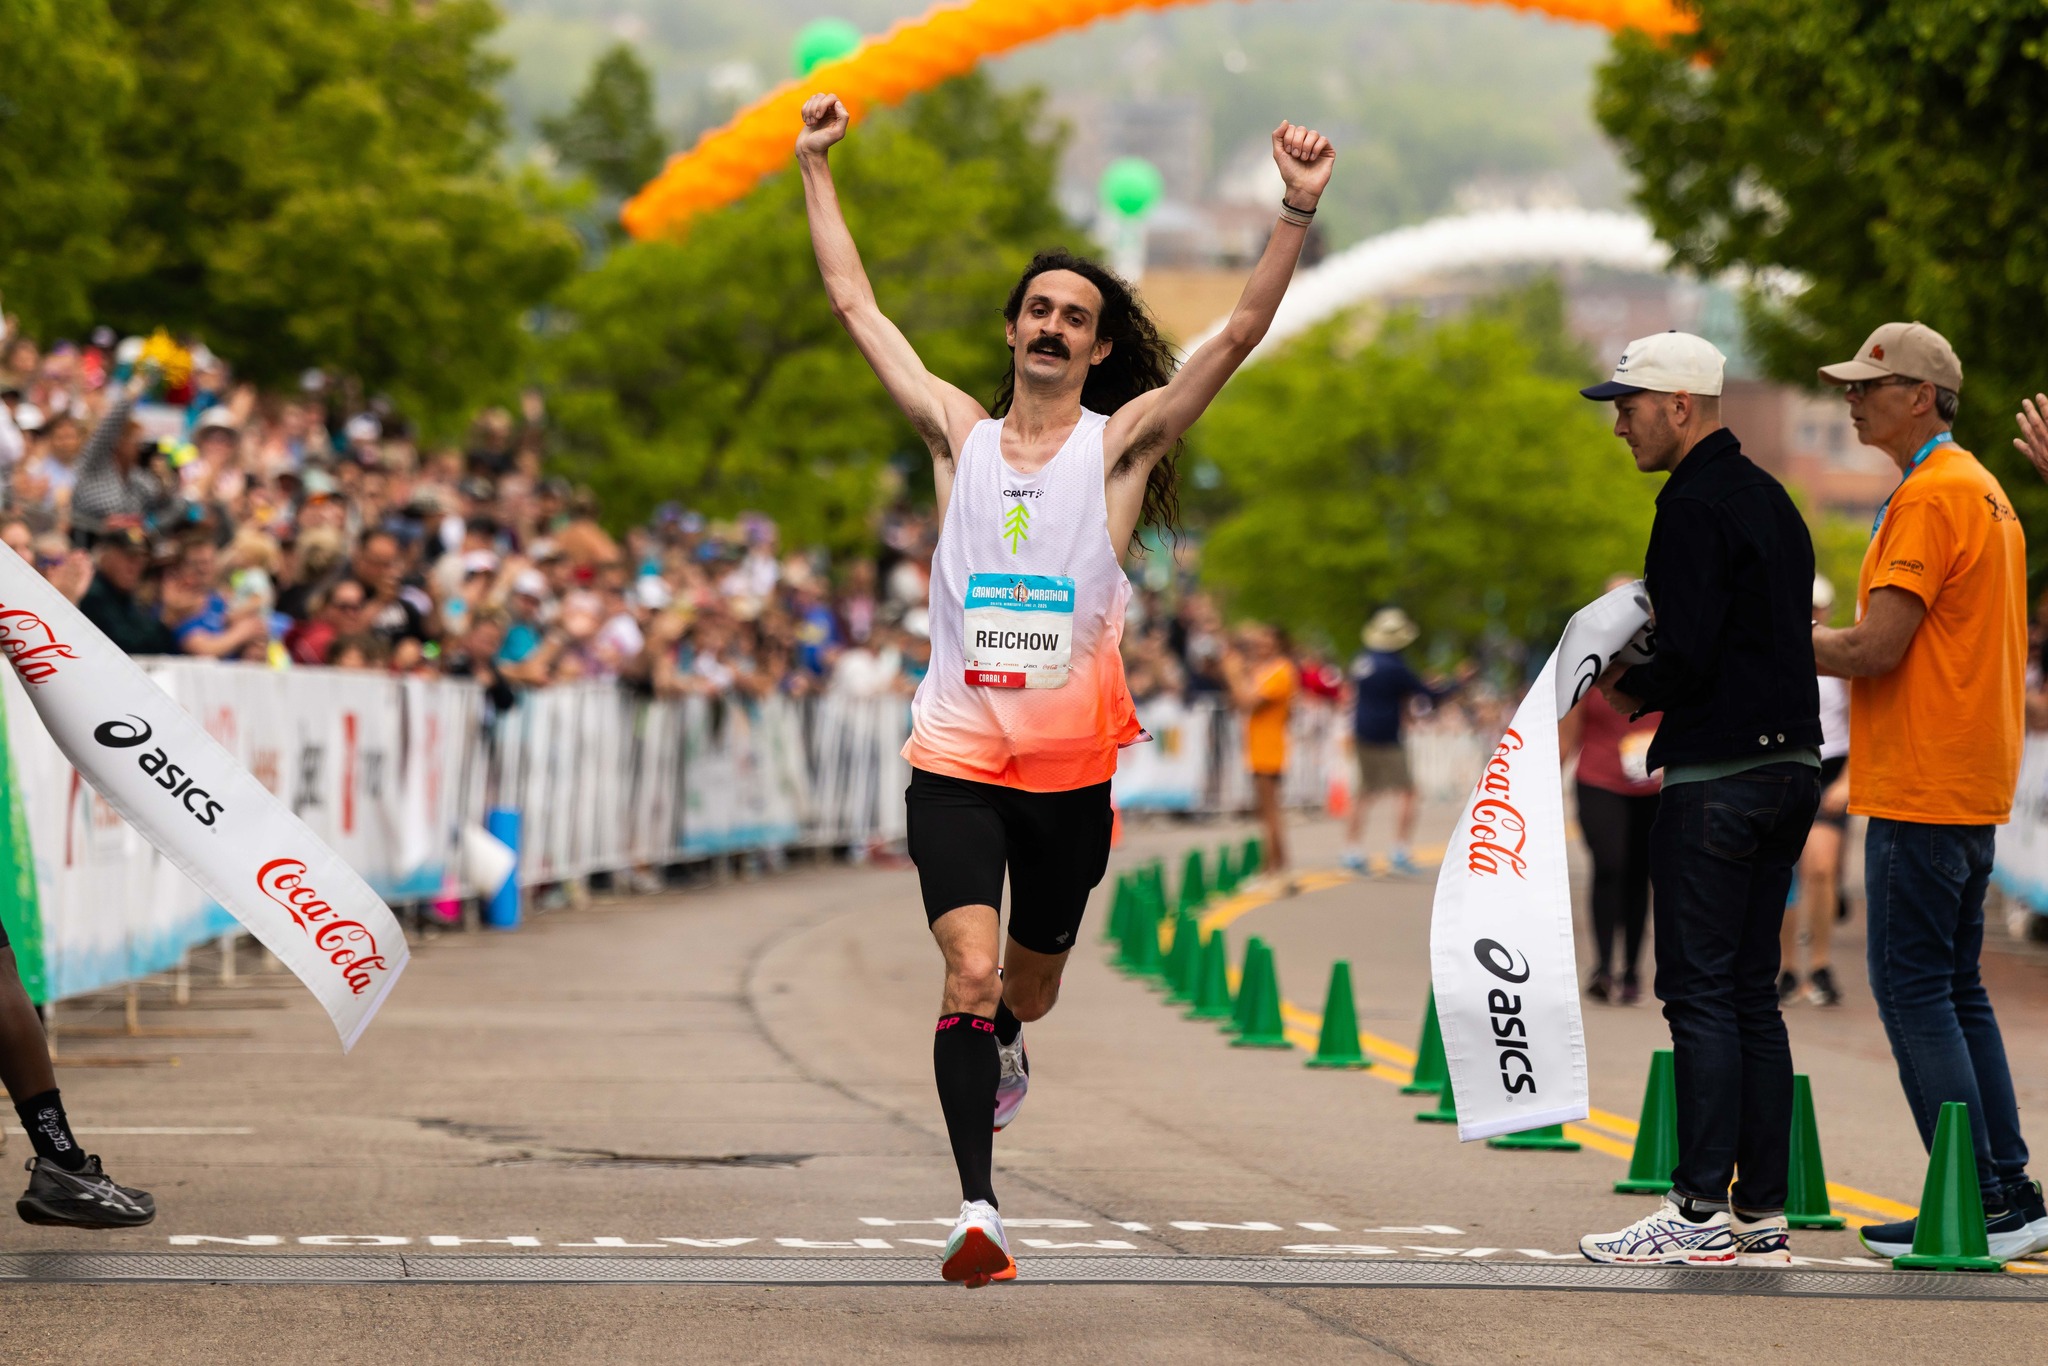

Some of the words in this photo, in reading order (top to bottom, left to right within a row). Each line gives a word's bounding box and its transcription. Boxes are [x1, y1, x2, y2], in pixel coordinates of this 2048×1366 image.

[1003, 490, 1036, 498] CRAFT
[972, 586, 1014, 600] GRANDMA'S
[1027, 589, 1069, 602] MARATHON
[976, 630, 1059, 651] REICHOW
[979, 673, 1001, 683] CORRAL
[1002, 675, 1007, 683] A
[138, 747, 224, 827] asics
[256, 858, 388, 995] Coca-Cola
[1488, 988, 1537, 1095] asics
